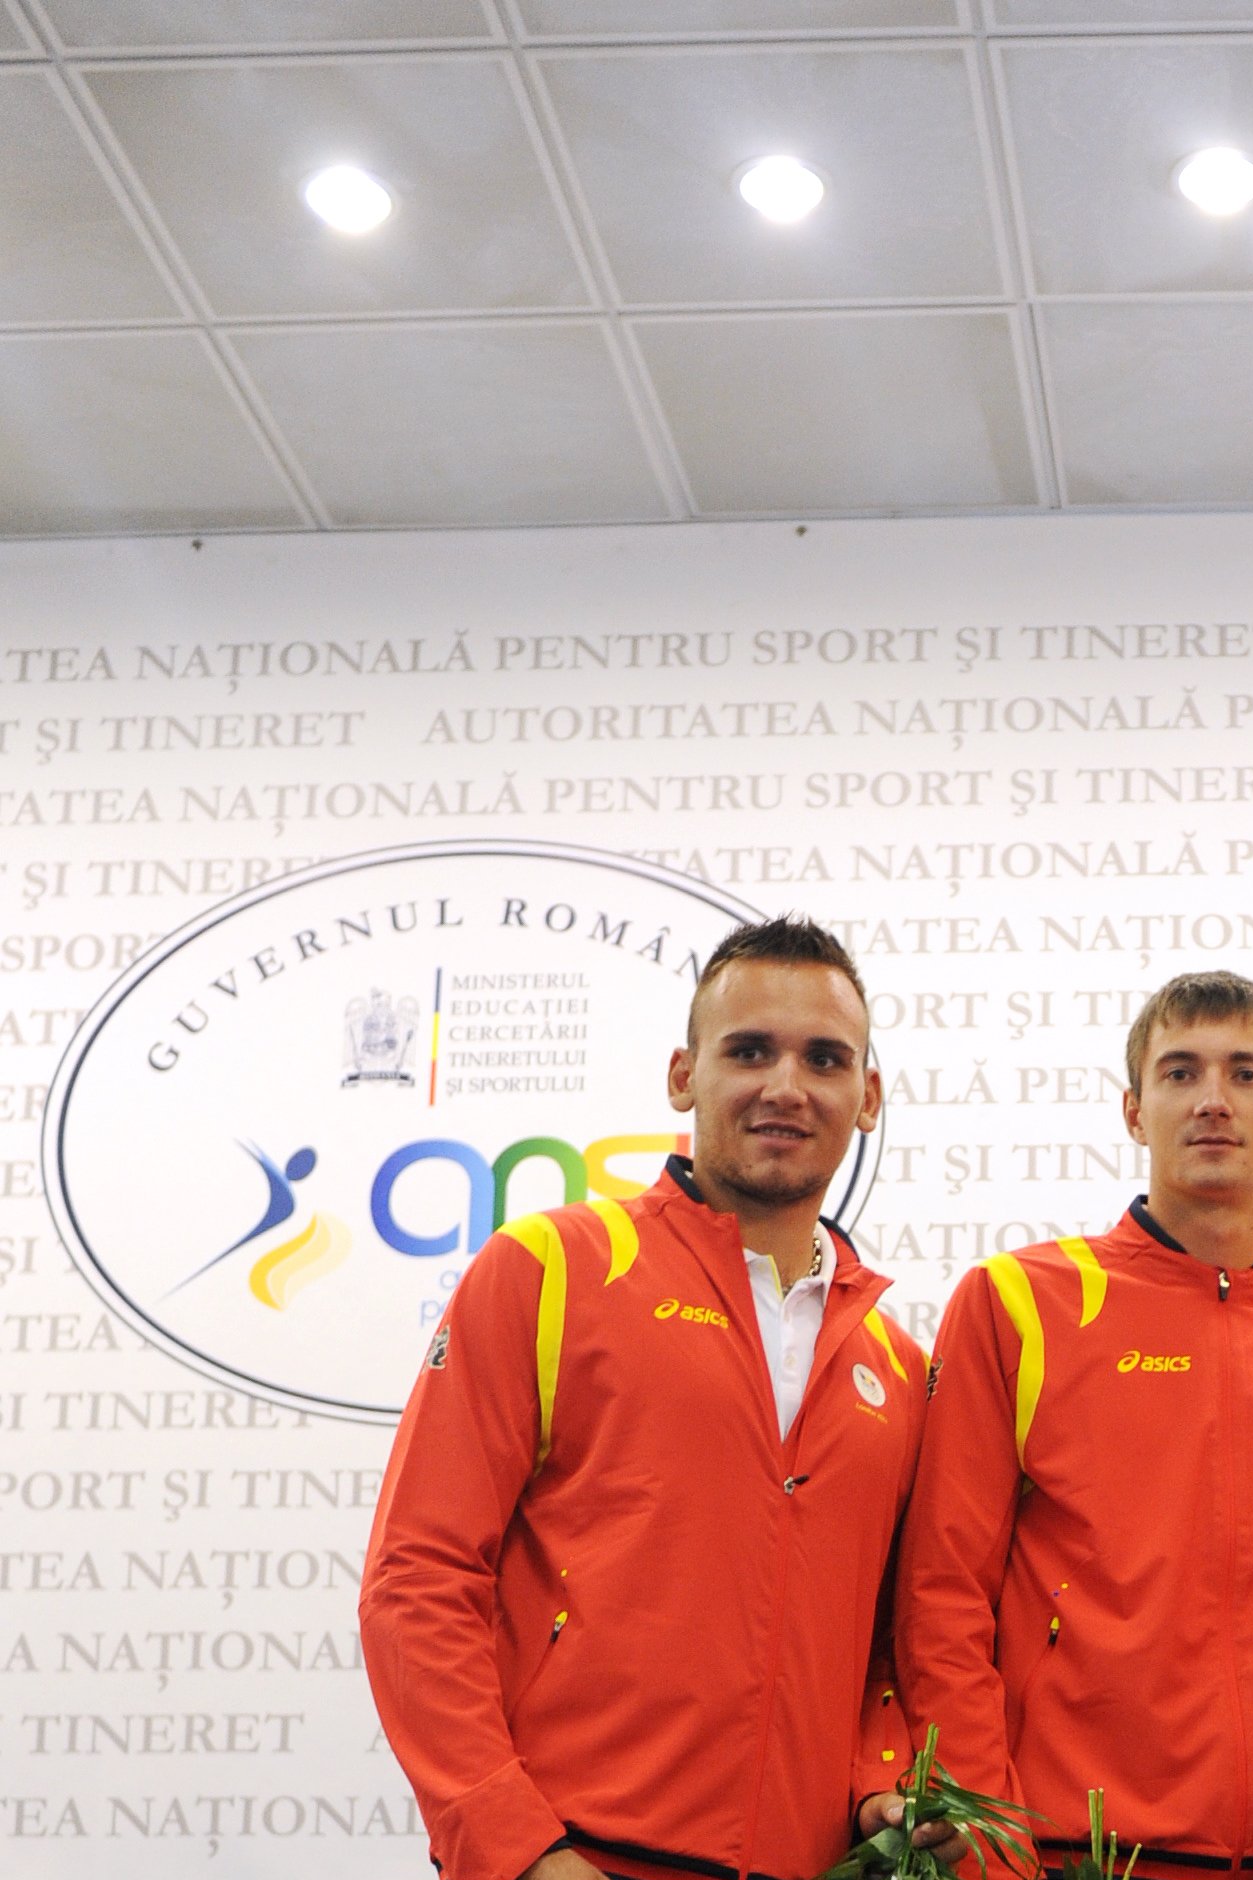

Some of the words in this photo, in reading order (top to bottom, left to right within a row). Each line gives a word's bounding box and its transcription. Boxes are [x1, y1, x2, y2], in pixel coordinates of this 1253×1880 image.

[494, 631, 733, 672] PENTRU
[752, 626, 938, 666] SPORT
[99, 710, 366, 753] TINERET
[420, 701, 838, 745] AUTORITATEA
[542, 773, 787, 814] PENTRU
[803, 768, 994, 811] SPORT
[146, 897, 465, 1075] GUVERNUL
[450, 972, 592, 991] MINISTERUL
[446, 1048, 586, 1069] TINERETULUI
[468, 1075, 586, 1095] SPORTULUI
[679, 1304, 730, 1330] asics
[1140, 1355, 1192, 1373] asics
[21, 1712, 305, 1756] TINERET
